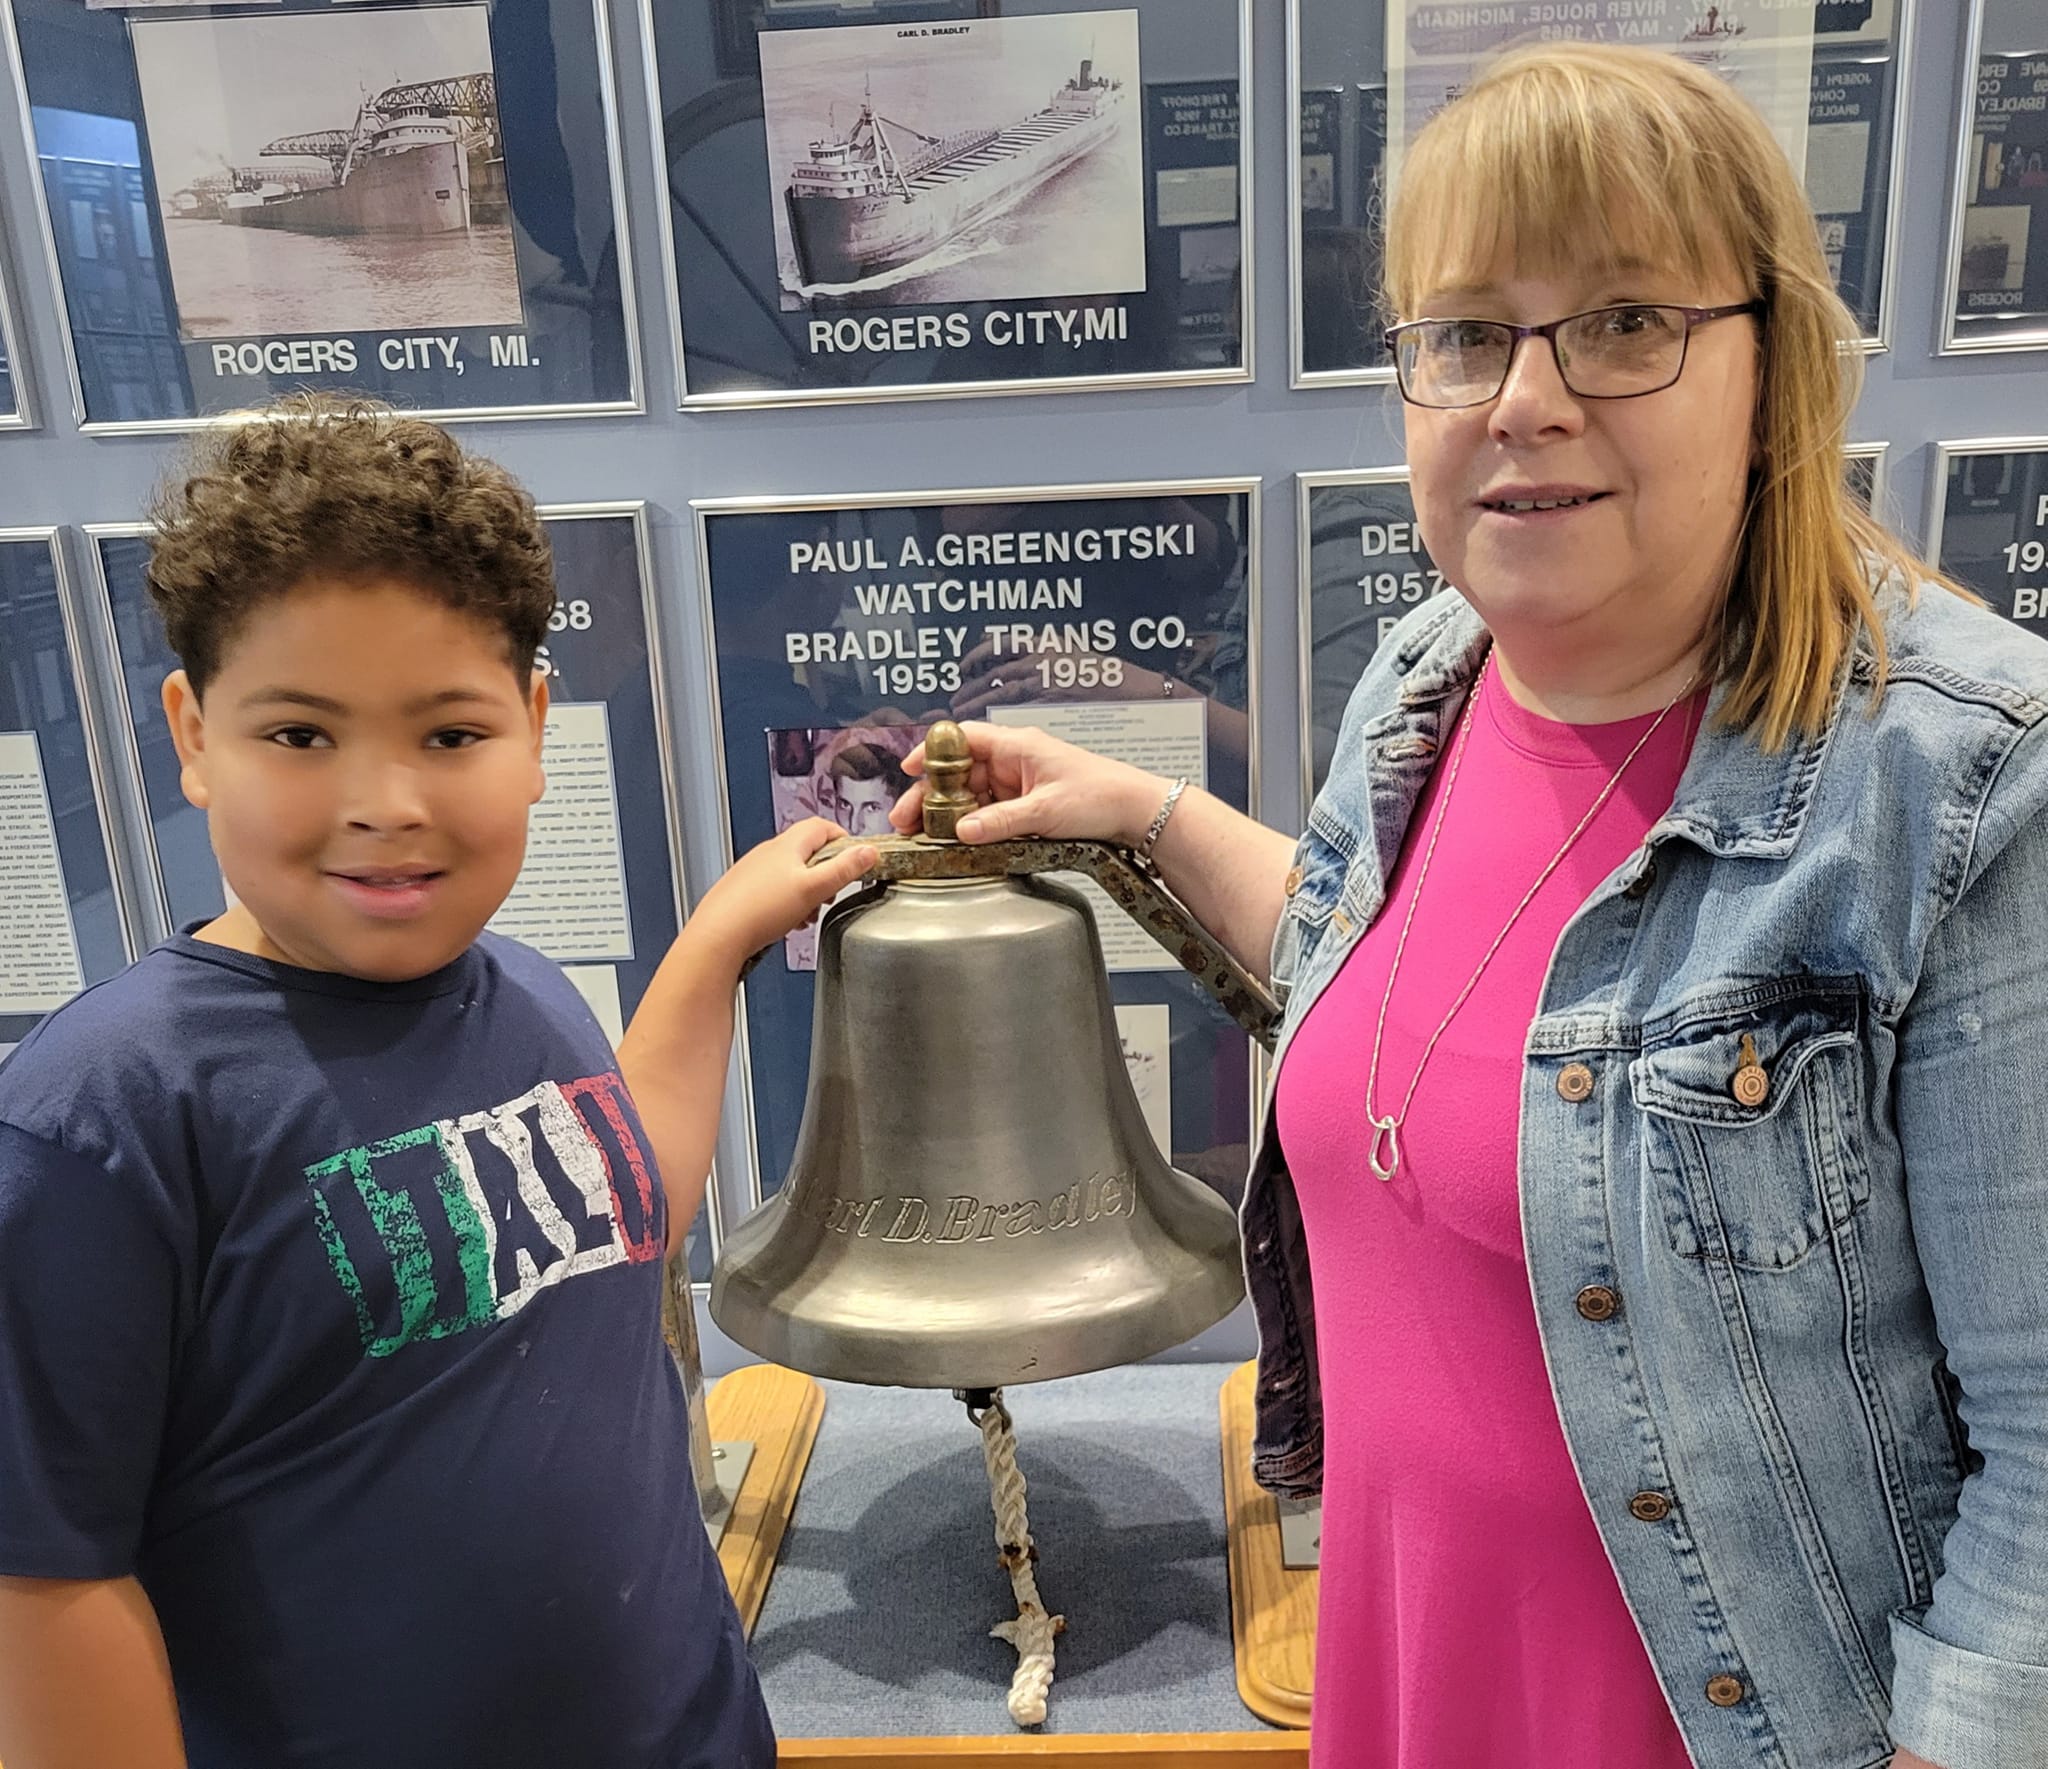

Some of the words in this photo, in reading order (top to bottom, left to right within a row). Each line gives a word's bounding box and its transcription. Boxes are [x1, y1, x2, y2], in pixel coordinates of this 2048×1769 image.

[897, 30, 919, 38] CARL
[932, 26, 970, 36] BRADLEY
[808, 313, 971, 353] ROGERS
[212, 339, 357, 376] ROGERS
[379, 336, 465, 375] CITY,
[490, 335, 540, 367] MI.
[790, 539, 888, 574] PAUL
[2003, 540, 2048, 574] 19
[854, 578, 1083, 616] WATCHMAN
[1357, 569, 1445, 606] 1957
[786, 626, 968, 664] BRADLEY
[985, 619, 1116, 656] TRANS
[1129, 616, 1193, 650] CO.
[872, 661, 962, 695] 1953
[1035, 656, 1124, 689] 1958
